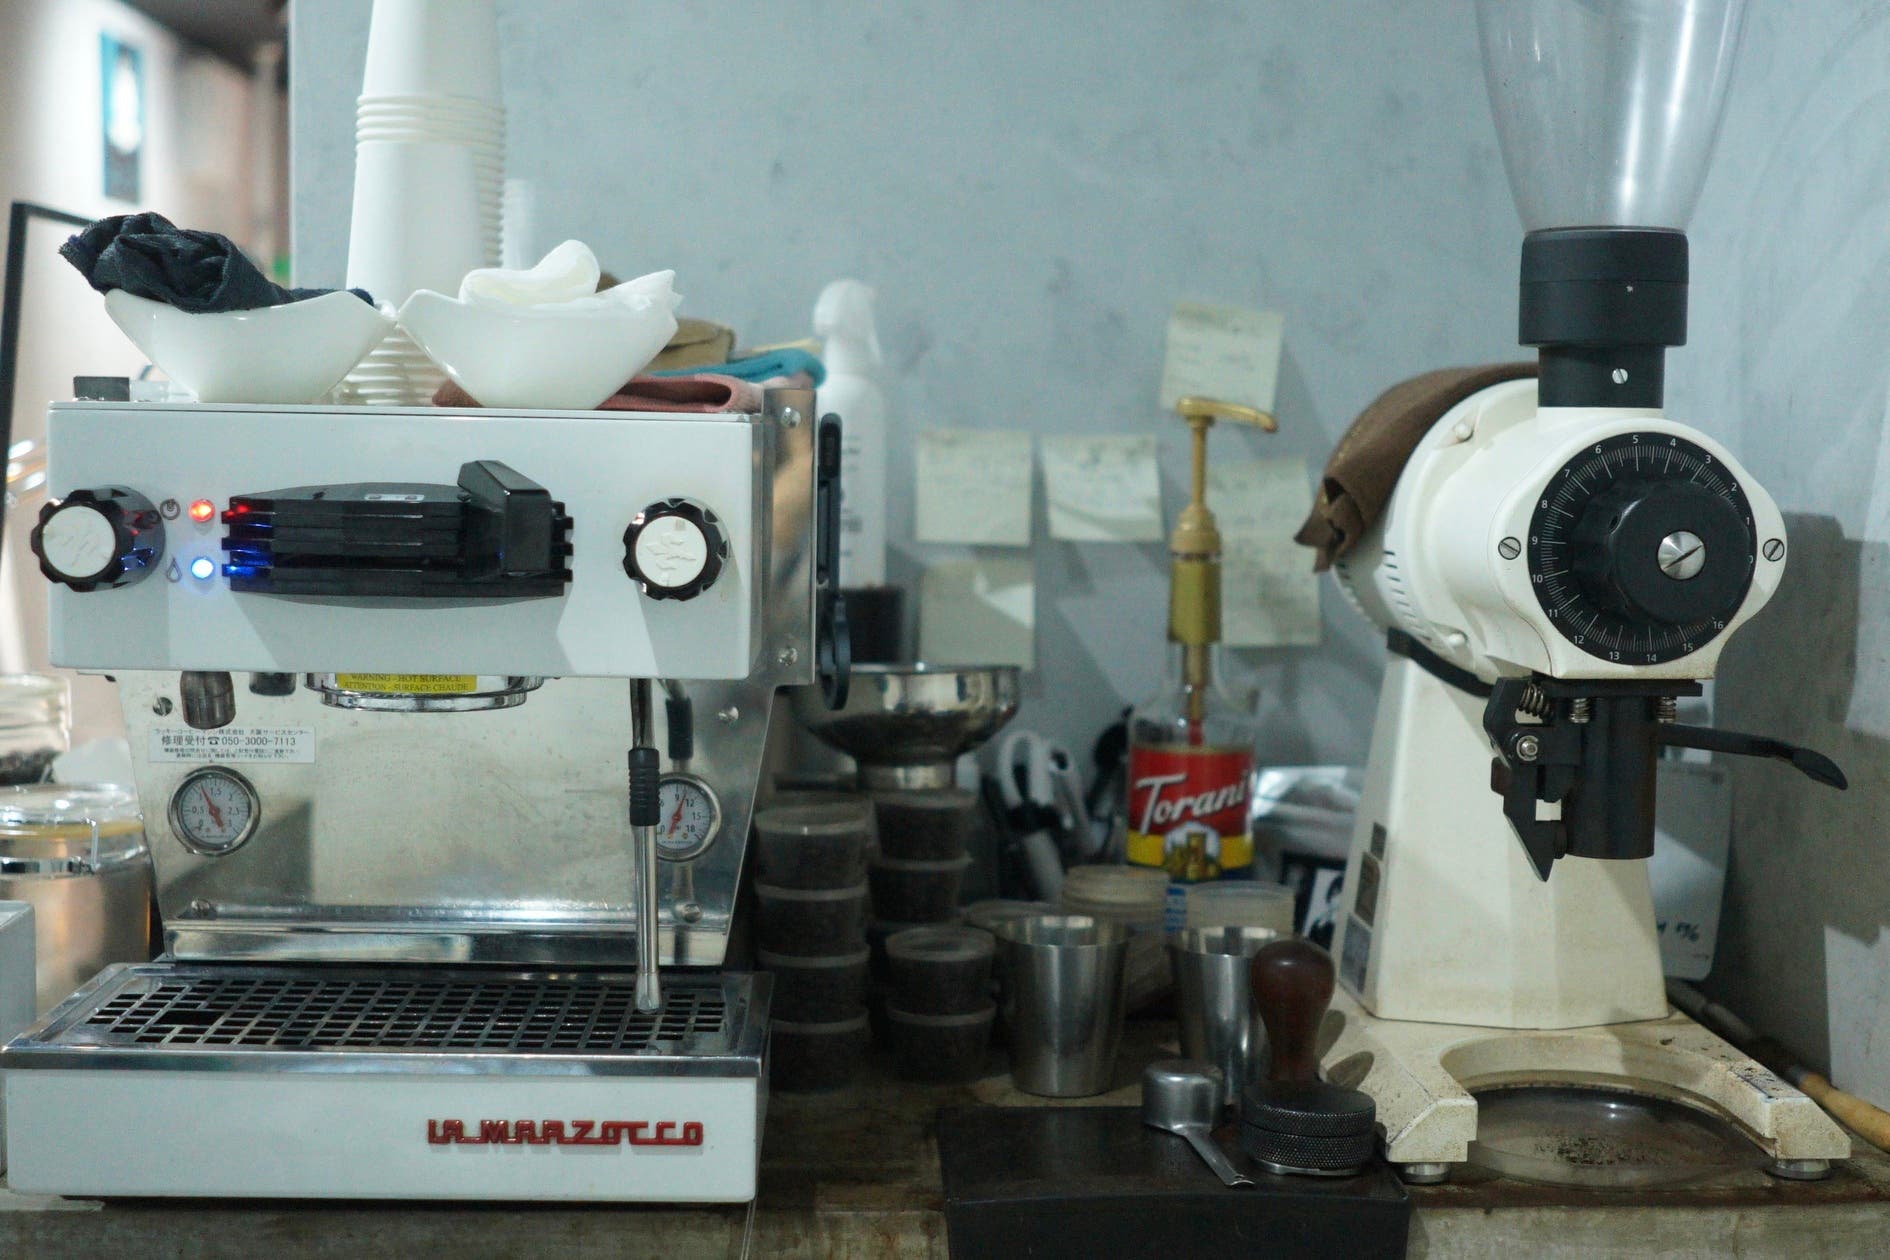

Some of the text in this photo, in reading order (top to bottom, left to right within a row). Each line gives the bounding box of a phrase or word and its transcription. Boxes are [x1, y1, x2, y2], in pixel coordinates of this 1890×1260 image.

[1632, 435, 1639, 444] 5
[1669, 438, 1677, 447] 4
[1595, 445, 1602, 454] 6
[1705, 454, 1711, 464] 3
[1564, 469, 1571, 478] 7
[1731, 482, 1738, 492] 2
[1541, 500, 1548, 509] 8
[1531, 536, 1538, 545] 9
[1532, 574, 1543, 583] 10
[1548, 609, 1559, 618] 11
[1713, 620, 1724, 629] 16
[1574, 635, 1584, 645] 12
[1683, 643, 1693, 651] 15
[1609, 651, 1619, 661] 13
[1646, 654, 1657, 662] 14
[221, 736, 296, 746] 050-3000-7113
[686, 798, 695, 808] 12
[1136, 769, 1249, 836] Torani
[692, 811, 702, 821] 15
[686, 824, 696, 833] 18
